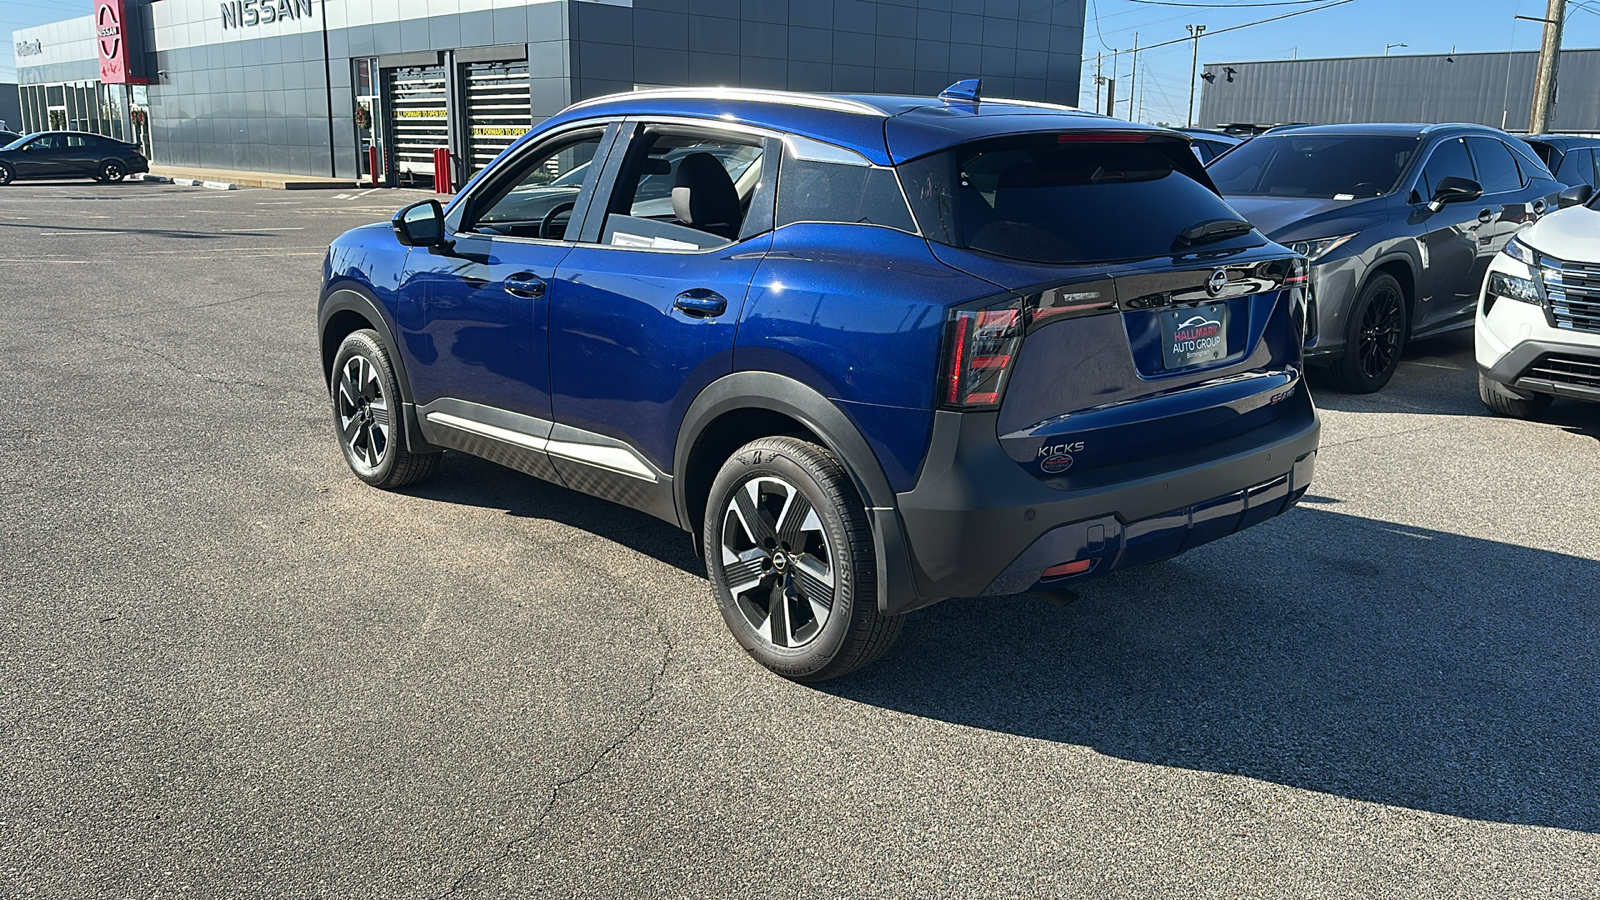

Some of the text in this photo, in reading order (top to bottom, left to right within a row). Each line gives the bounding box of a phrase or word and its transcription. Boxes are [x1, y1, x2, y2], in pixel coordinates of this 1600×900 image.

[221, 0, 312, 30] NISSAN
[97, 26, 118, 37] NISSAN
[403, 110, 422, 118] FORWARD
[483, 128, 504, 136] FORWARD
[1174, 325, 1218, 342] HALLMARK
[1173, 336, 1221, 354] AUTO GROUP
[1038, 441, 1085, 457] KICKS
[824, 508, 853, 619] BRIDGESTONE
[762, 661, 814, 677] TURANZA
